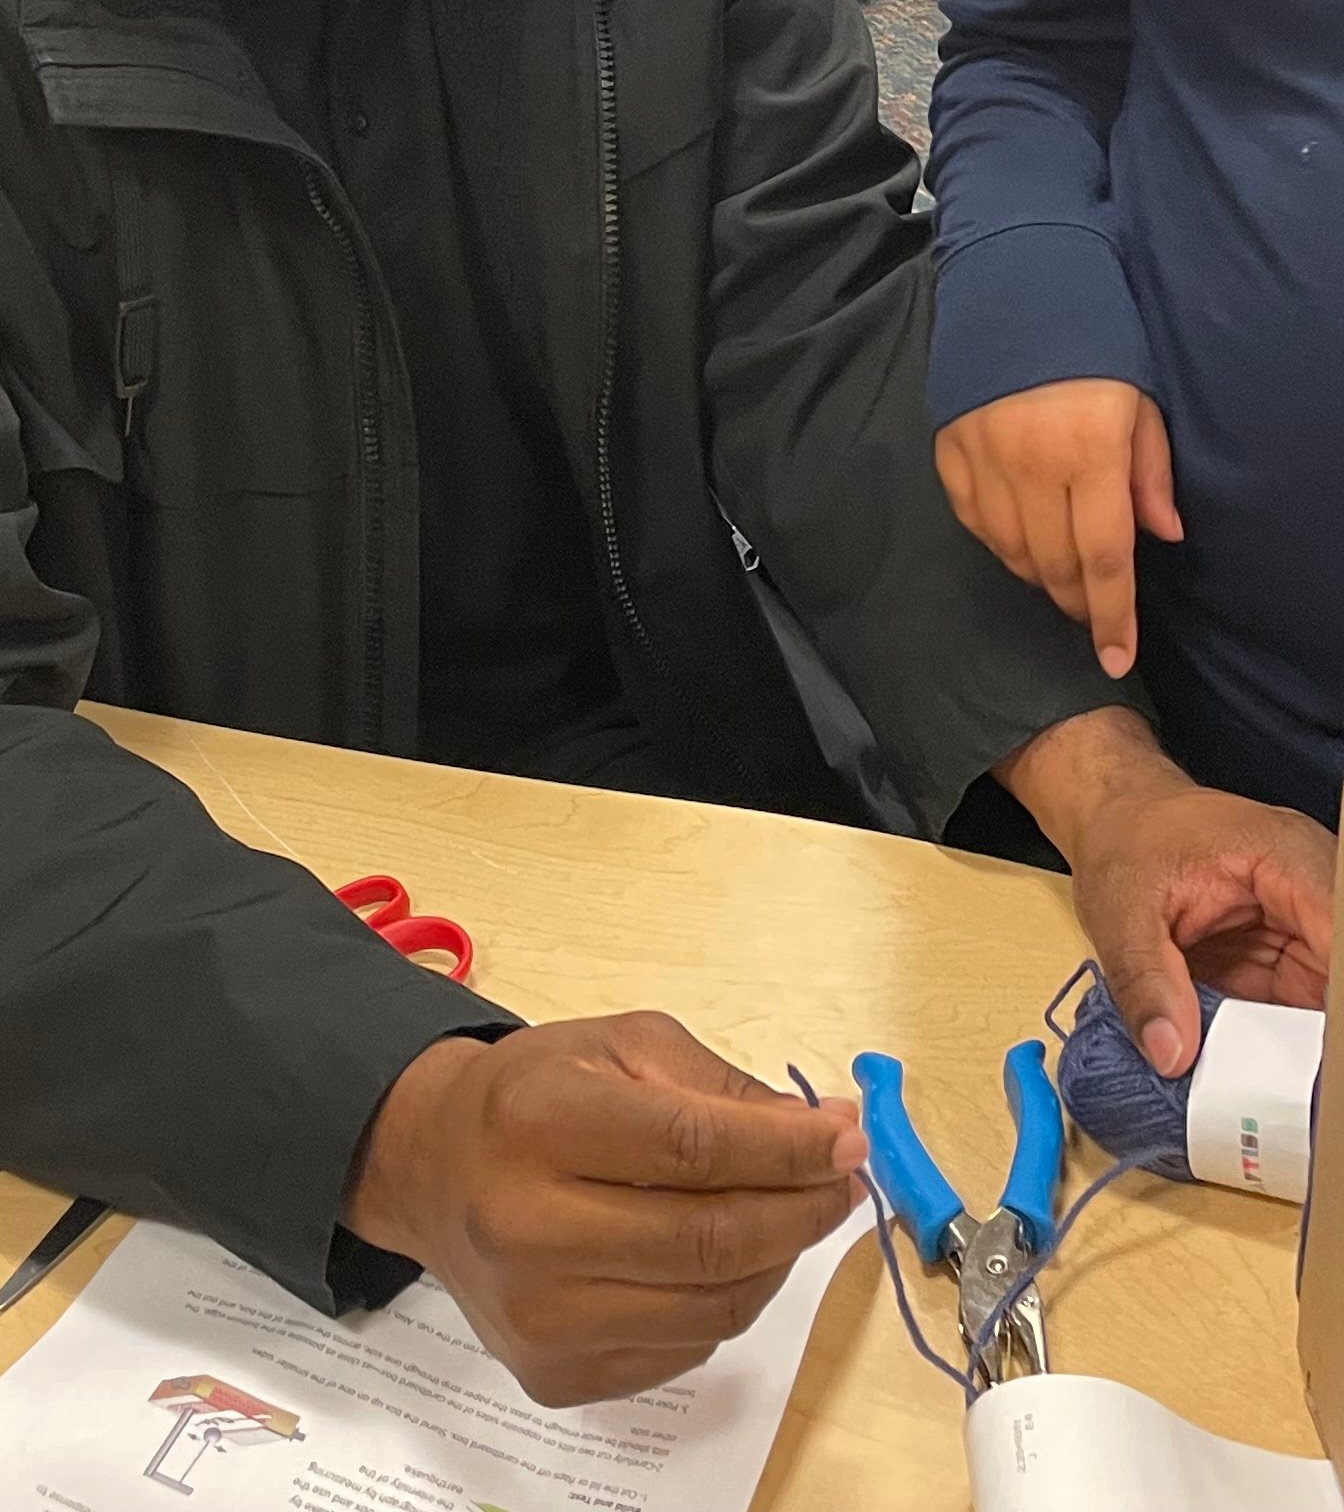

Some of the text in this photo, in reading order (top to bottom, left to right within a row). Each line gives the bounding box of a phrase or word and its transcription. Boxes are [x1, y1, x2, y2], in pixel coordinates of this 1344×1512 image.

[187, 1289, 204, 1302] the
[257, 1308, 273, 1322] the
[315, 1327, 331, 1341] the
[435, 1328, 479, 1353] rim of the
[310, 1372, 325, 1385] the
[403, 1362, 440, 1386] through
[325, 1379, 336, 1388] of
[338, 1384, 356, 1396] one
[399, 1376, 445, 1403] cardboard
[370, 1397, 384, 1408] up
[464, 1388, 491, 1405] paper
[385, 1403, 402, 1418] box
[447, 1399, 462, 1412] the
[462, 1405, 474, 1415] of
[491, 1401, 507, 1414] the
[402, 1412, 419, 1428] the
[510, 1406, 531, 1420] pass
[421, 1420, 447, 1438] Stand
[470, 1440, 518, 1464] cardboard
[359, 1465, 376, 1479] the
[520, 1460, 535, 1472] the
[536, 1467, 551, 1479] off
[553, 1470, 576, 1484] flaps
[293, 1477, 331, 1500] use the
[365, 1488, 377, 1500] by
[620, 1487, 637, 1499] Cut
[289, 1494, 302, 1506] by
[436, 1495, 454, 1511] the
